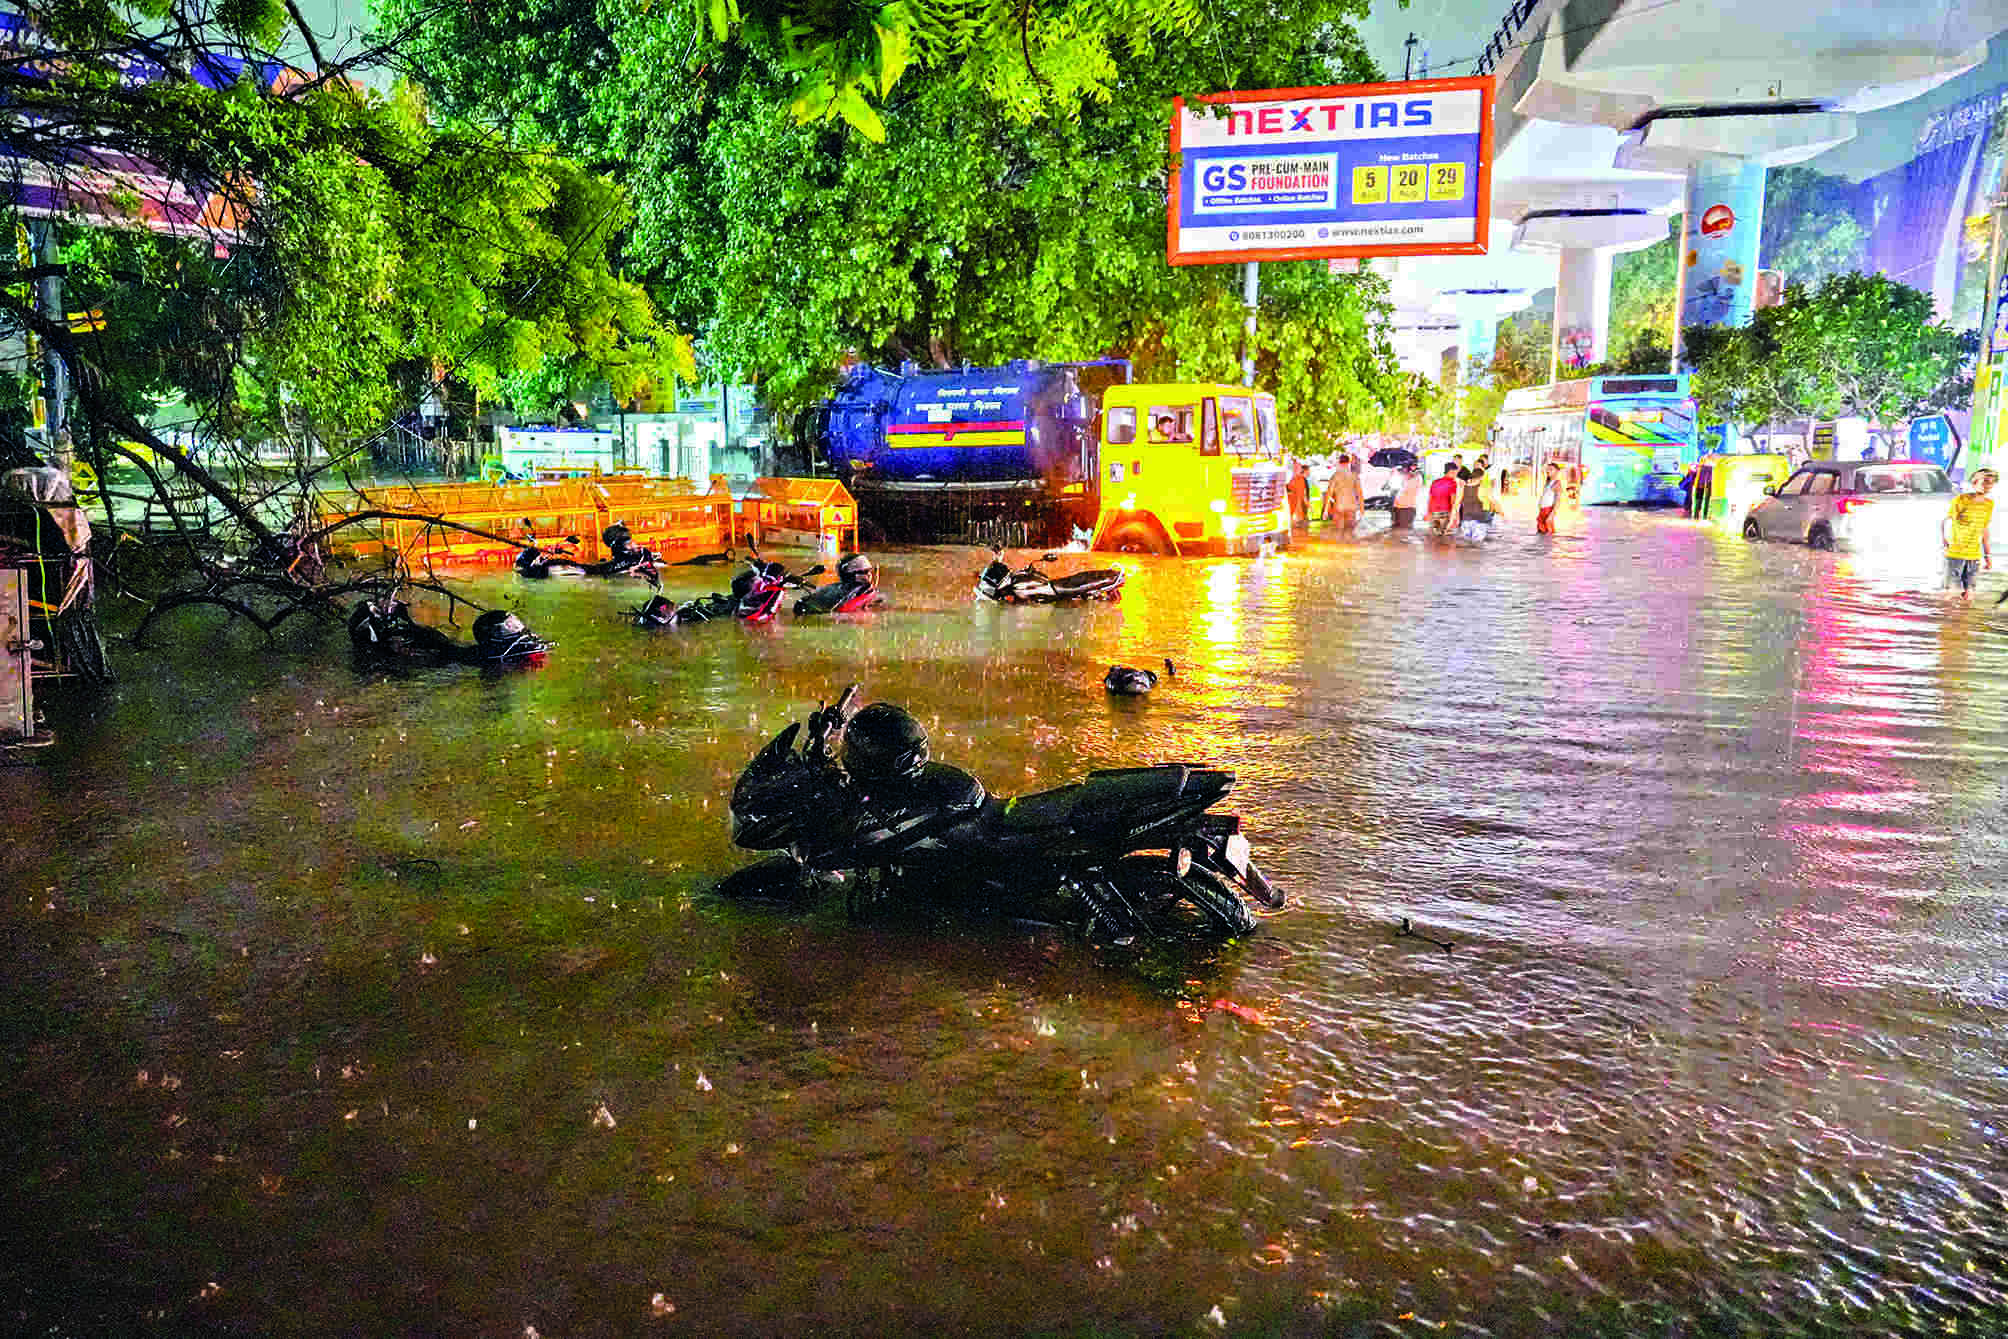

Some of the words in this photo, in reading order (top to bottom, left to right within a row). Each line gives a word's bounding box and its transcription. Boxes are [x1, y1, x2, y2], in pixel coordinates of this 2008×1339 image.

[1354, 99, 1433, 129] IAS
[1251, 160, 1329, 176] PRE-CUM-MAIN
[1437, 167, 1457, 185] 29
[1203, 164, 1247, 192] GS
[1251, 174, 1329, 191] FOUNDATION
[1365, 171, 1377, 189] 5
[1399, 169, 1419, 187] 20
